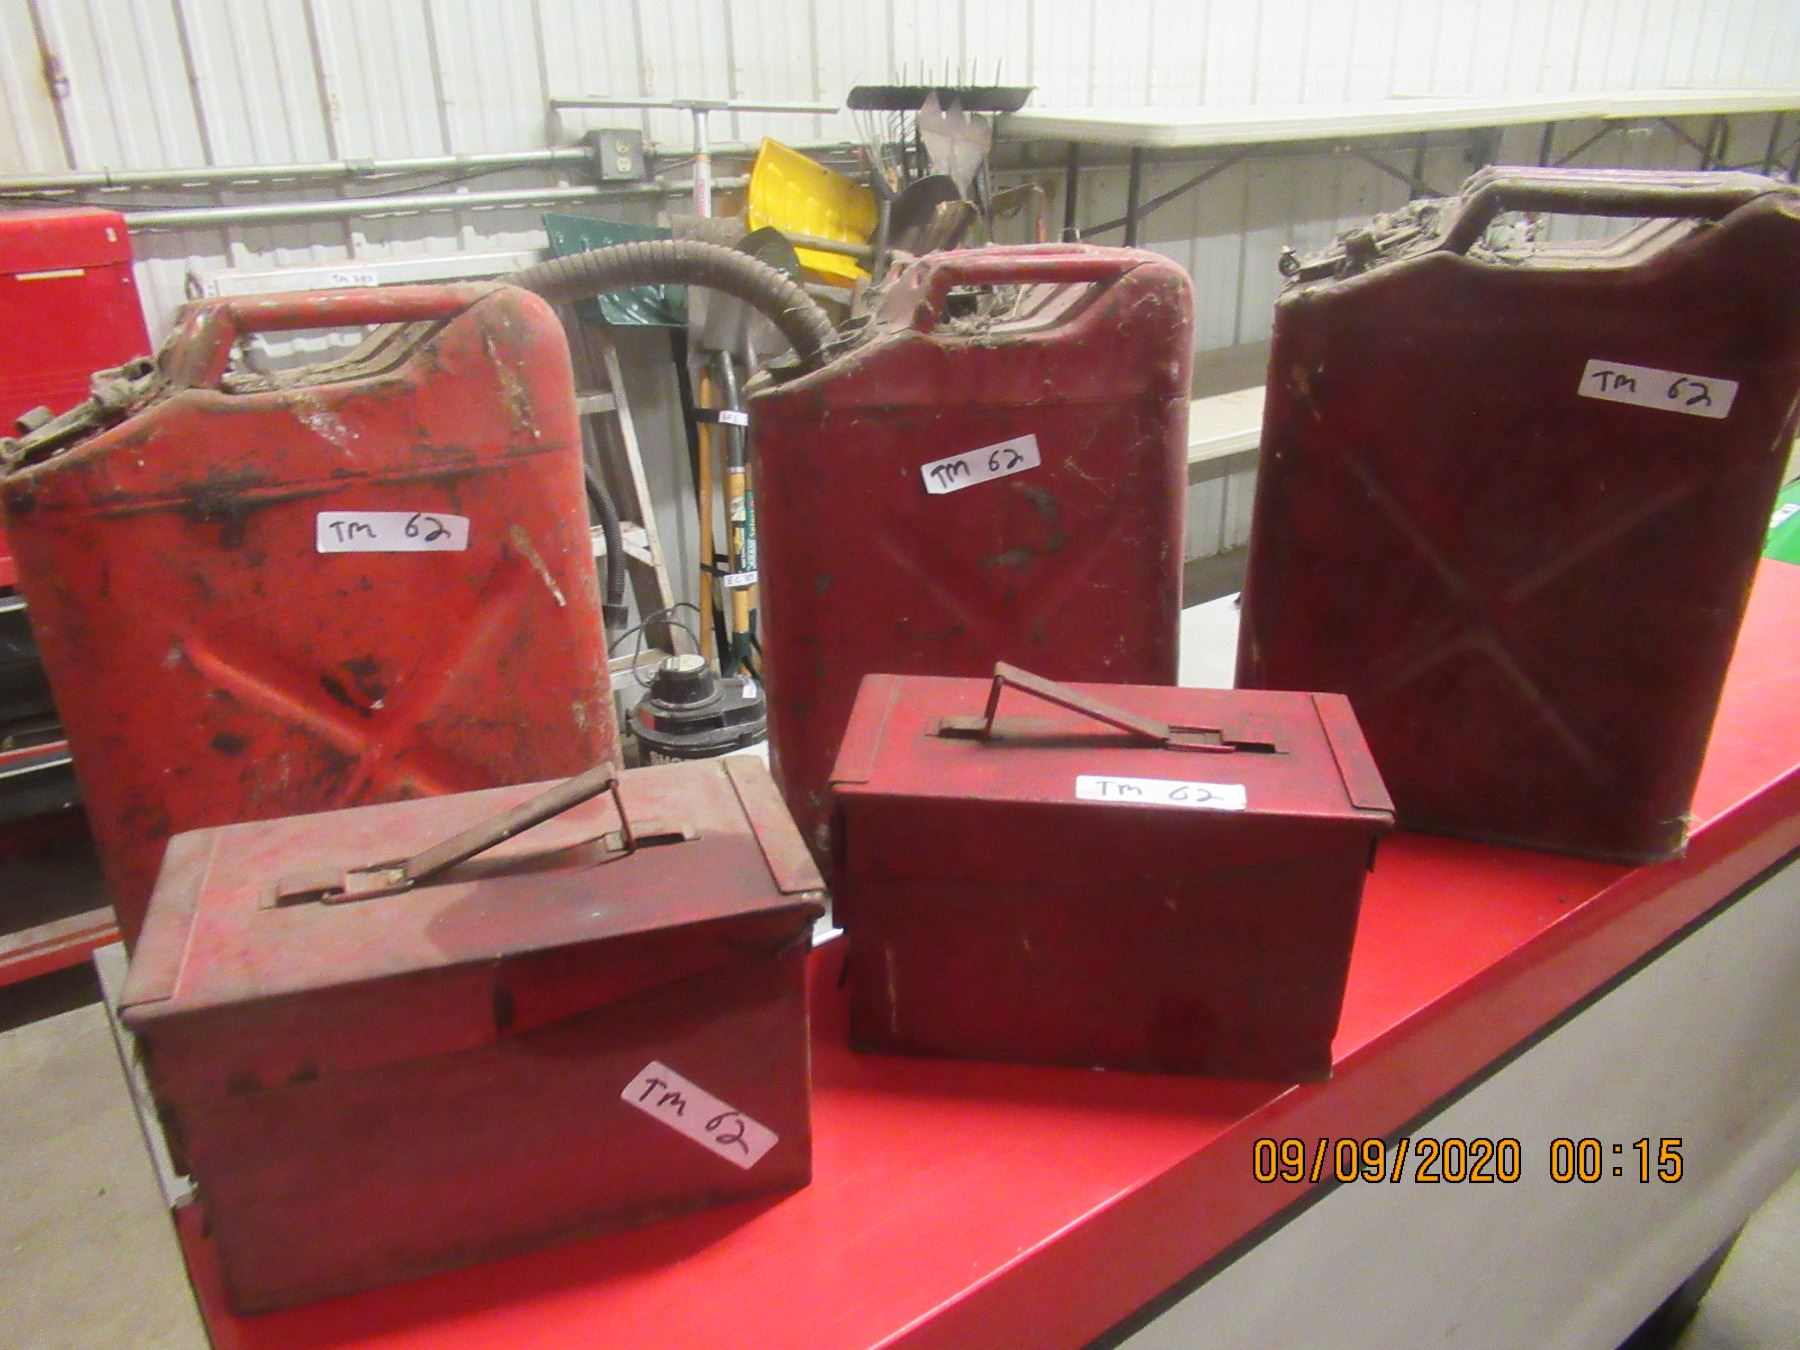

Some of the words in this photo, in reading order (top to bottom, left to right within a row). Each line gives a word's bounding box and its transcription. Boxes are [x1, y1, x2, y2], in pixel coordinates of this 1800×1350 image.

[1592, 371, 1636, 392] TM
[1668, 377, 1711, 406] 62
[930, 460, 970, 489] TM
[989, 449, 1024, 472] 62
[329, 521, 377, 542] TM
[405, 513, 451, 542] 62
[1096, 781, 1142, 796] TM
[1168, 785, 1224, 802] 62
[639, 1078, 687, 1116] TM
[705, 1111, 749, 1154] 62
